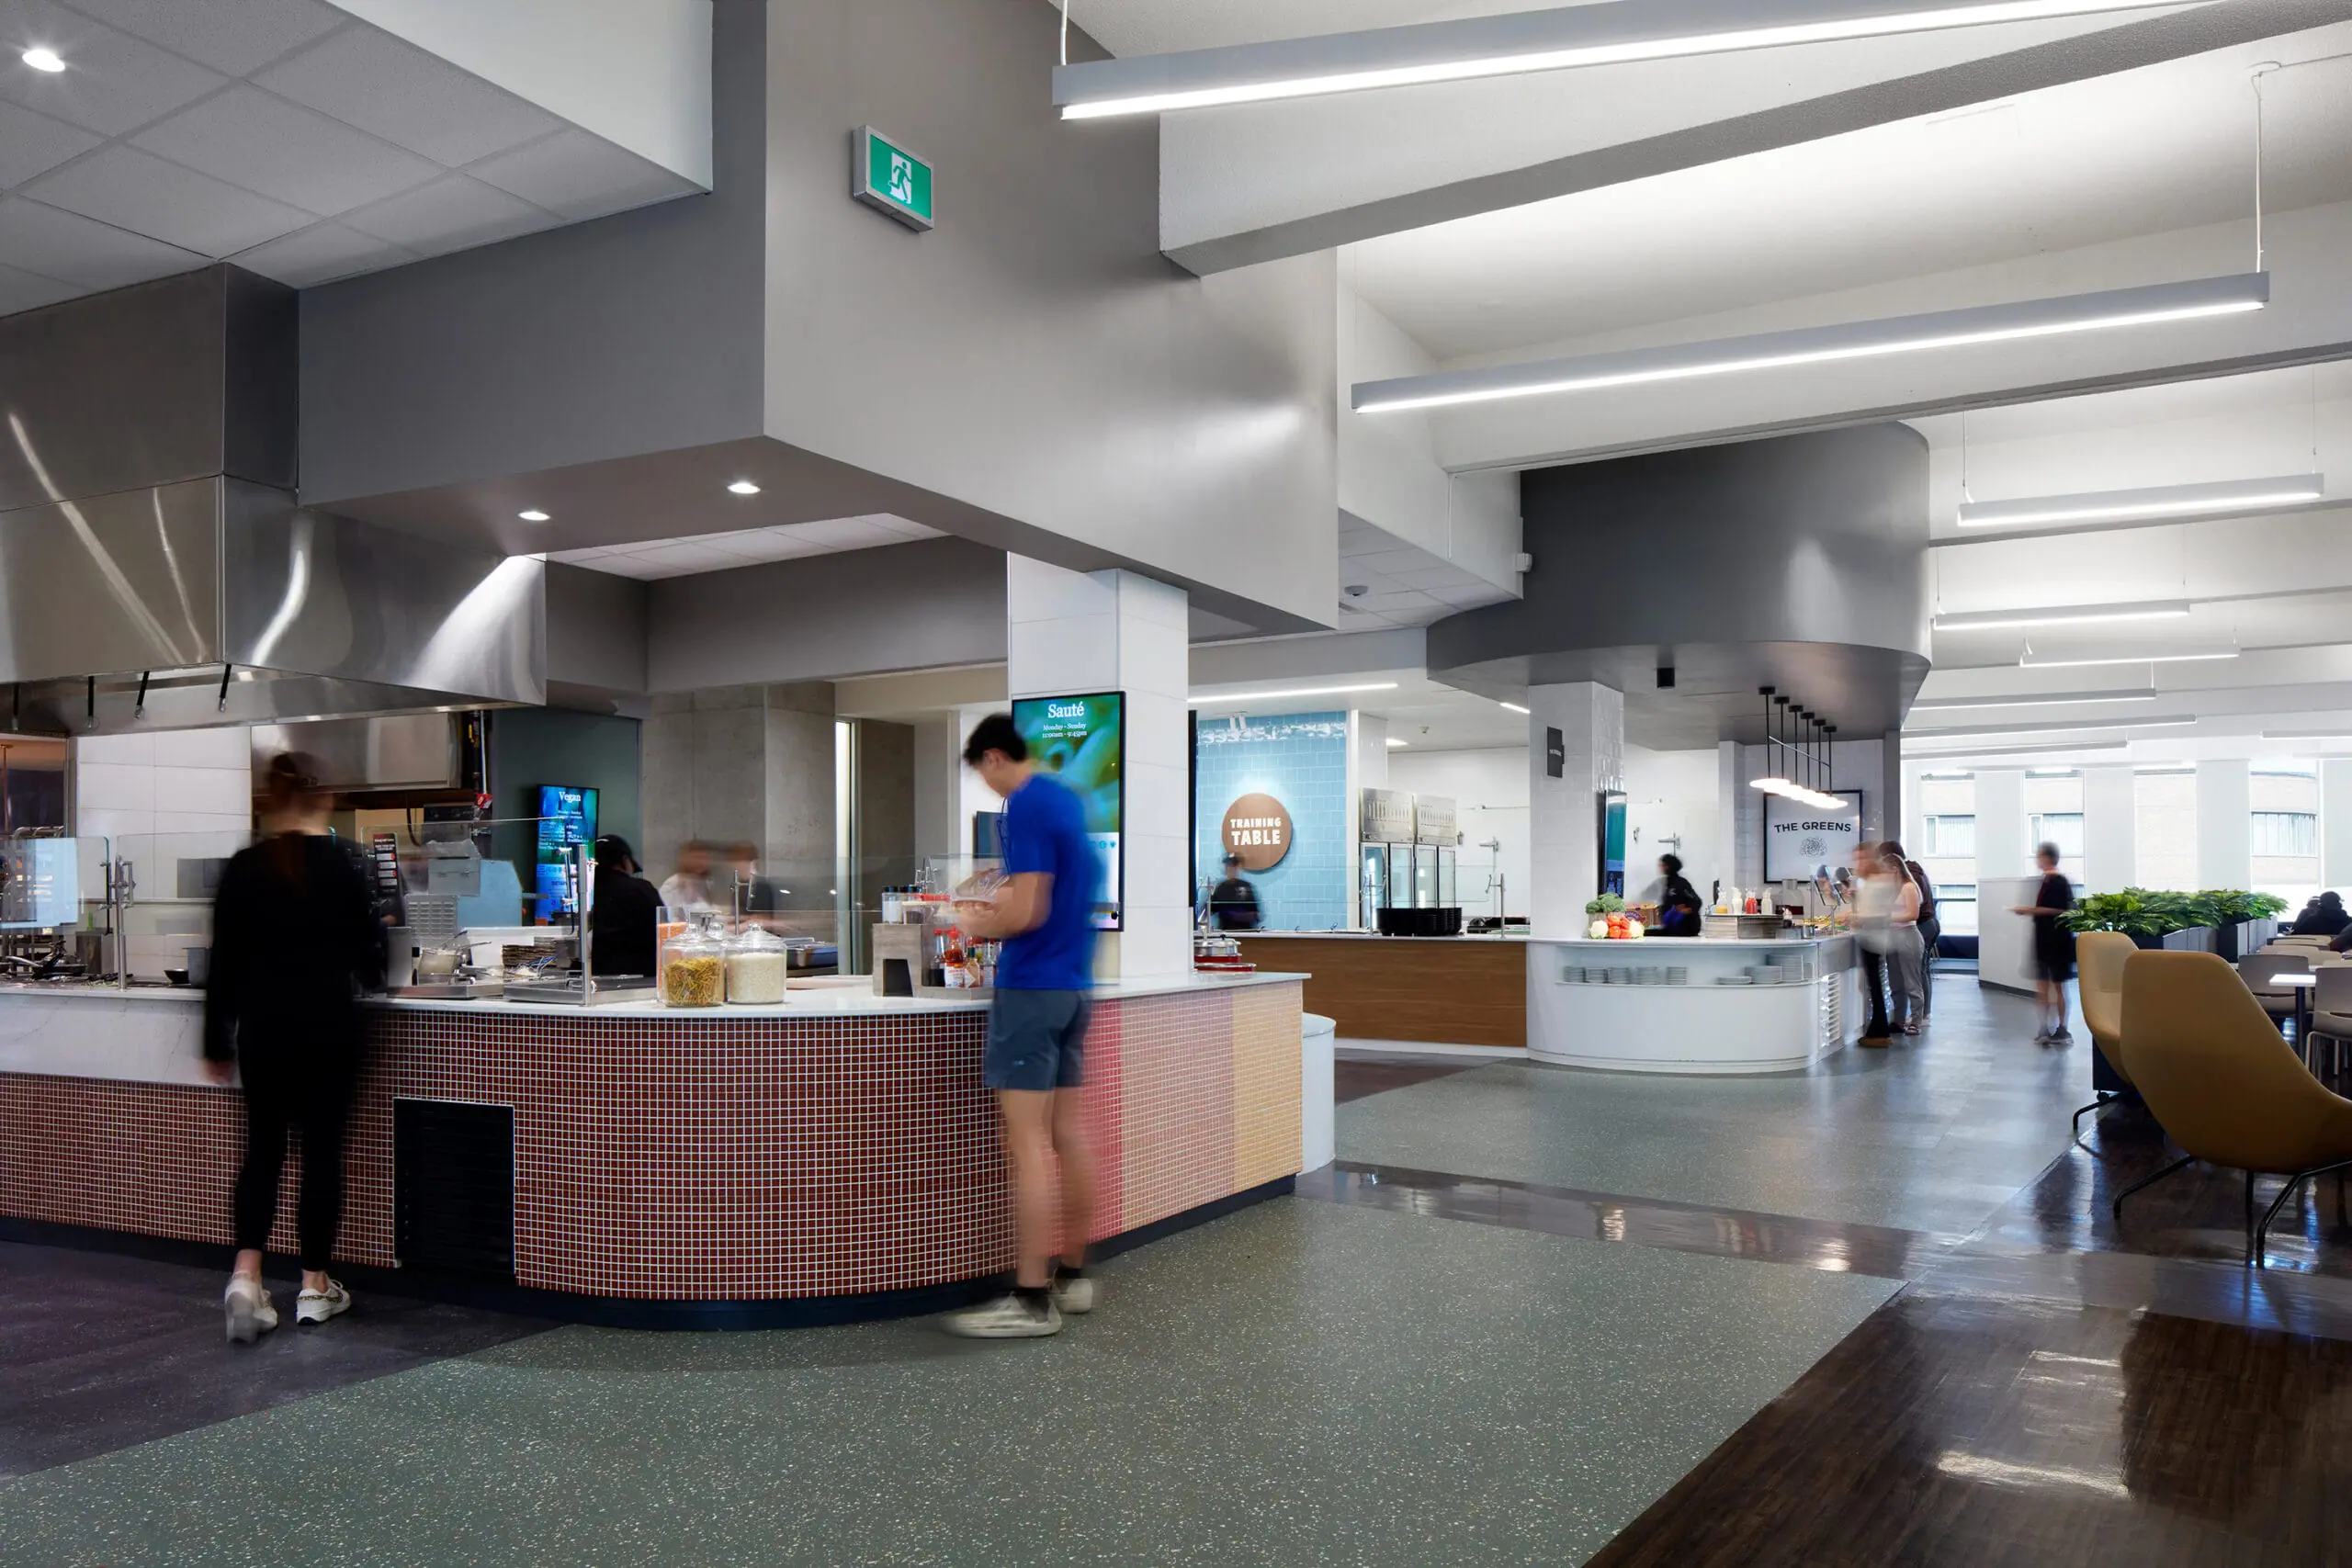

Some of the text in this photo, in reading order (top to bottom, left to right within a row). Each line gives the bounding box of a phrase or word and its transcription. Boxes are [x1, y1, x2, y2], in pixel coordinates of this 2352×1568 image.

[1047, 701, 1085, 718] Sauté
[559, 791, 582, 803] Vegan
[1230, 817, 1282, 829] TRAINING
[1774, 821, 1851, 833] THE GREENS
[1231, 829, 1281, 846] TABLE
